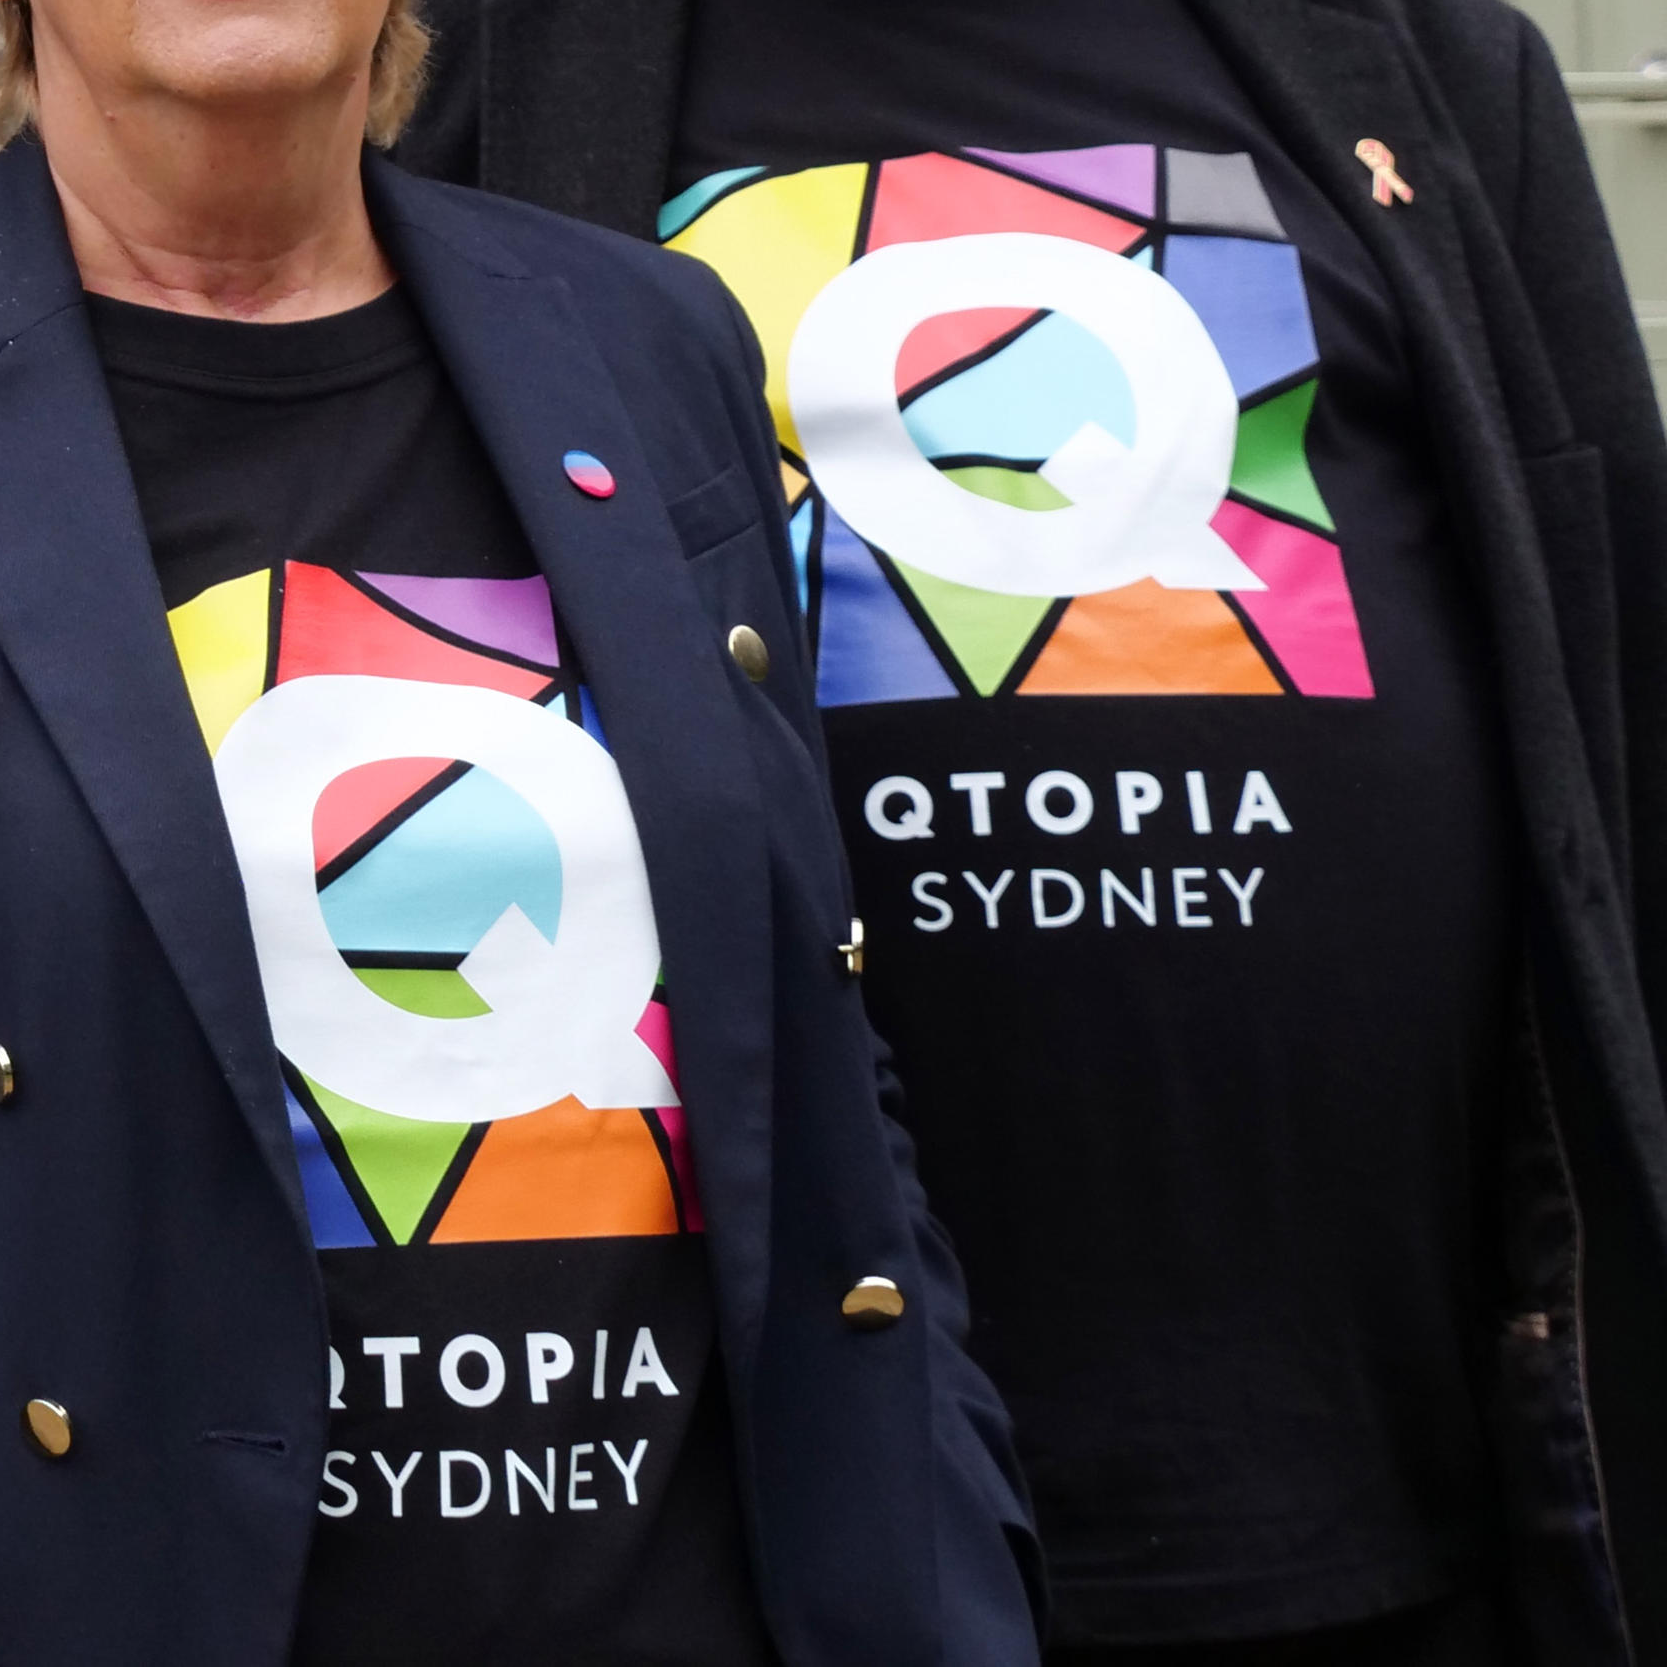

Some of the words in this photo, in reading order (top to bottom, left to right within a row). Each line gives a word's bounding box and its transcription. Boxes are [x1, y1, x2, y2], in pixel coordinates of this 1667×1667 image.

[864, 770, 1293, 841] QTOPIA
[912, 867, 1265, 932] SYDNEY
[329, 1327, 680, 1409] TOPIA
[318, 1438, 649, 1519] SYDNEY
